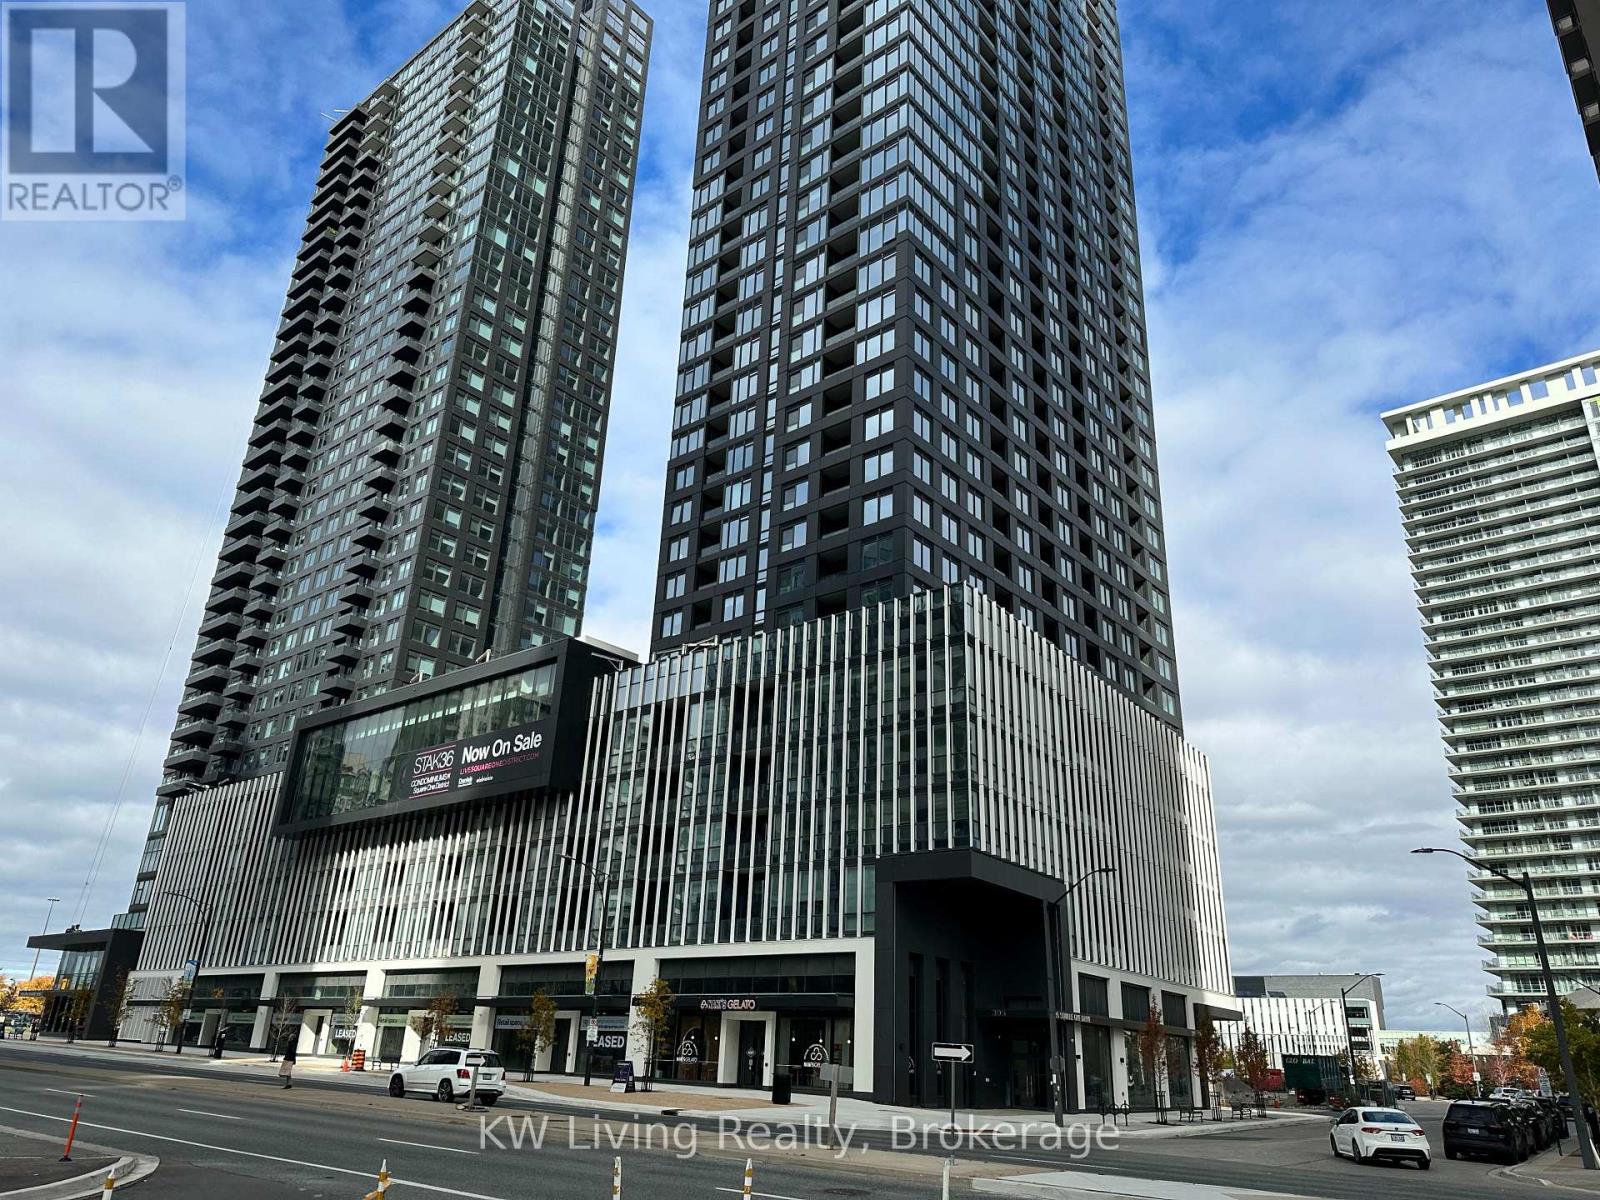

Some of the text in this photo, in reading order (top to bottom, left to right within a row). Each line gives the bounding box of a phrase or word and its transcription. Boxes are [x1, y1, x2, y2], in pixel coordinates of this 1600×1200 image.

[461, 731, 542, 764] Now On Sale
[413, 749, 455, 774] STAK36
[459, 752, 540, 775] LIVESQUAREONEDISTRICT.COM
[727, 999, 756, 1010] GELATO
[335, 1029, 357, 1038] LEASED
